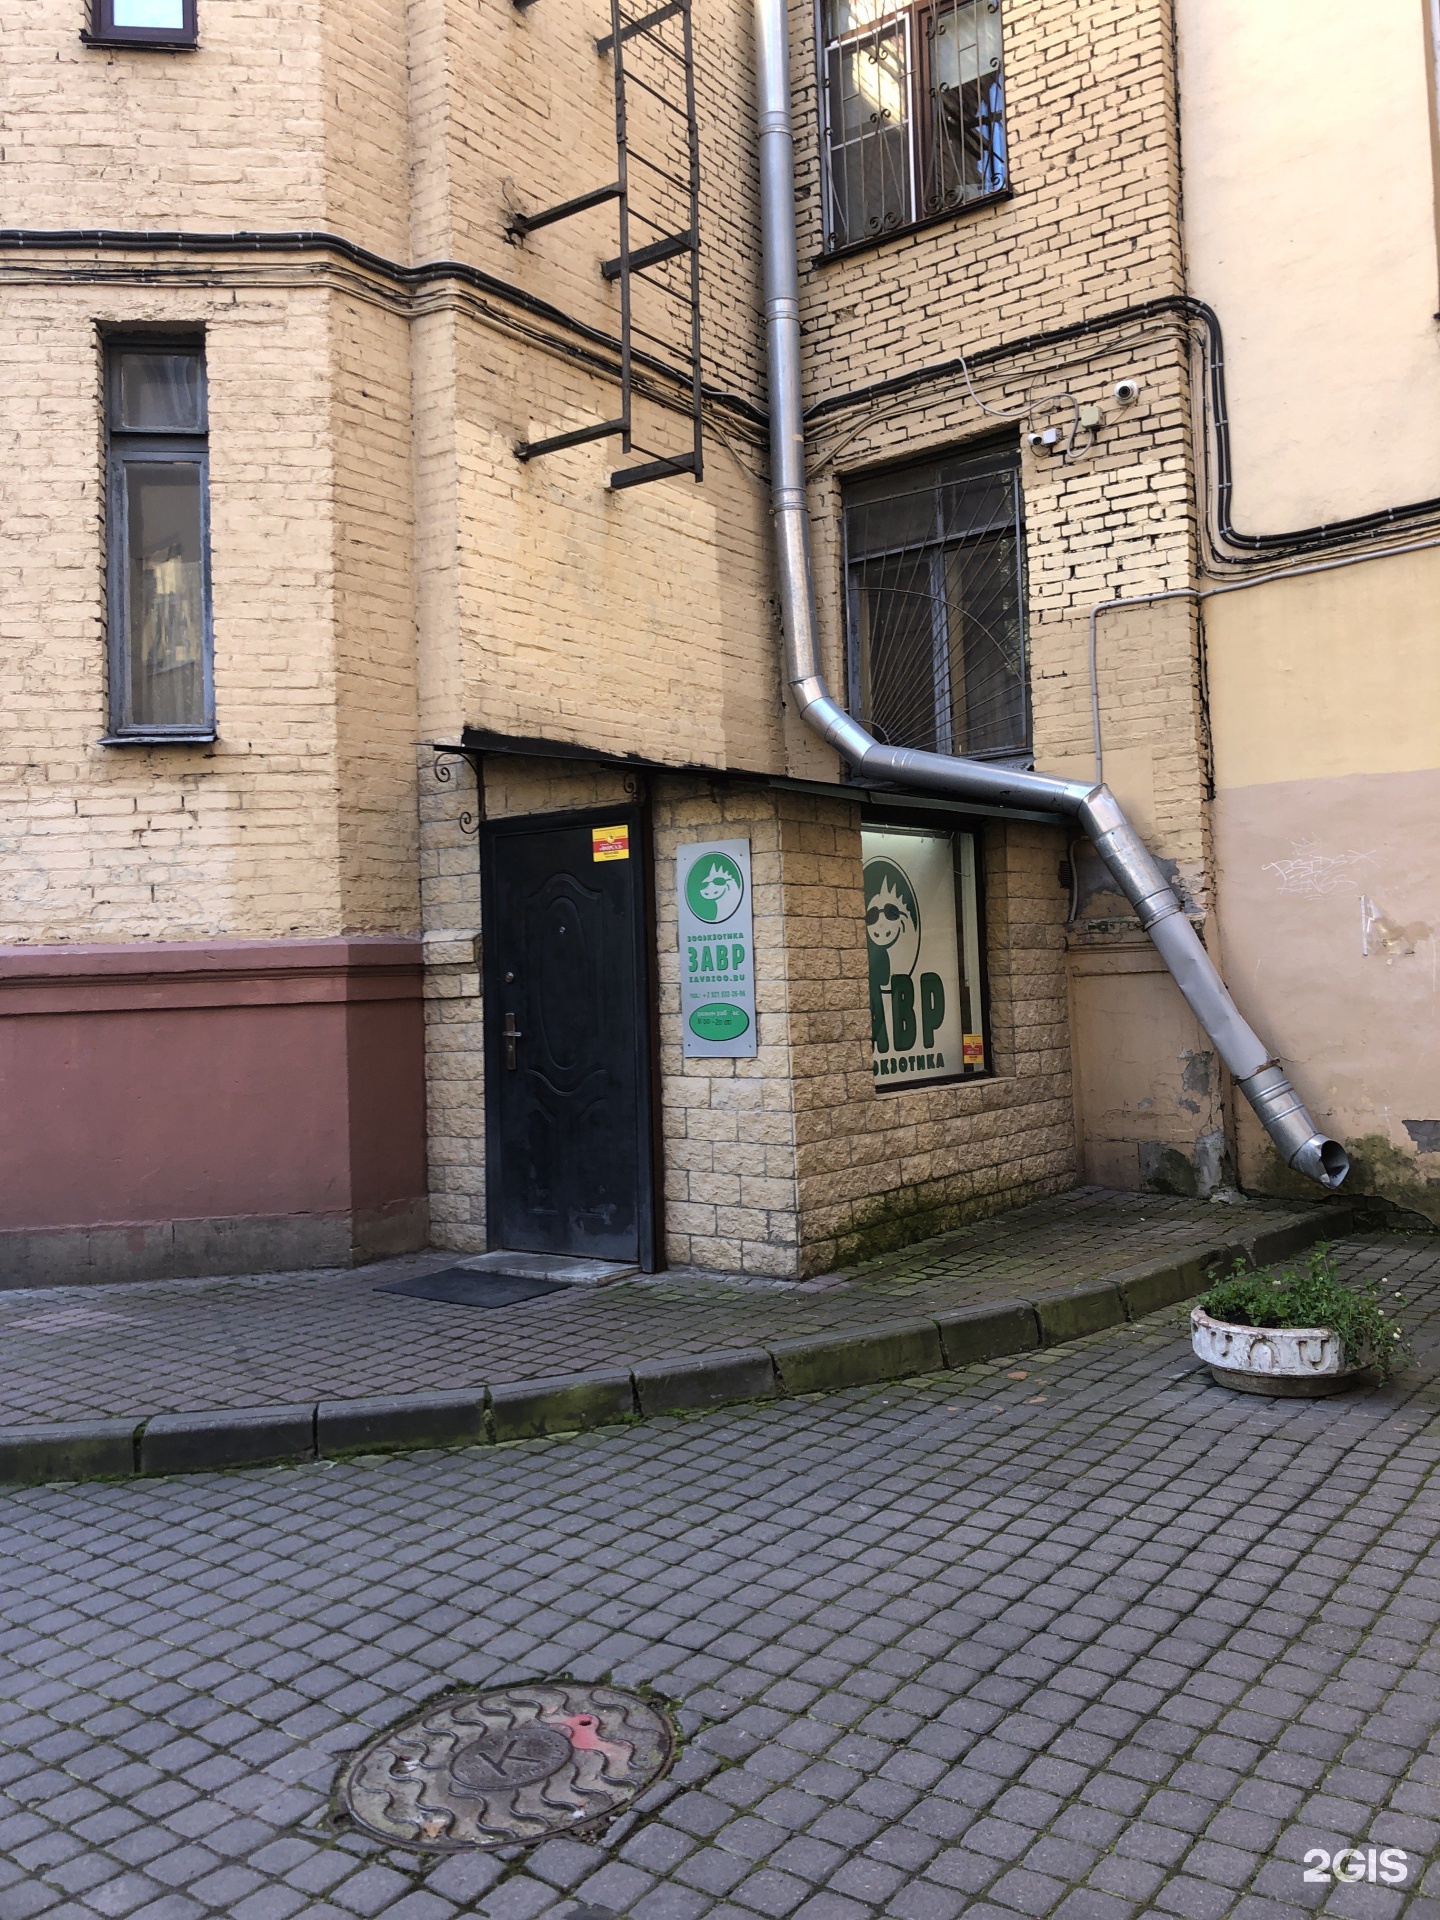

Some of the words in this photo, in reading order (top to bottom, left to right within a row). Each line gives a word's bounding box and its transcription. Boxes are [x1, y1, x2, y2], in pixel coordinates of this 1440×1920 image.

[687, 932, 744, 942] ЗООЭКЗОТИКА
[688, 943, 745, 972] ЗАВР
[689, 974, 745, 983] ZAVRZOO.RU
[870, 971, 945, 1054] АВР
